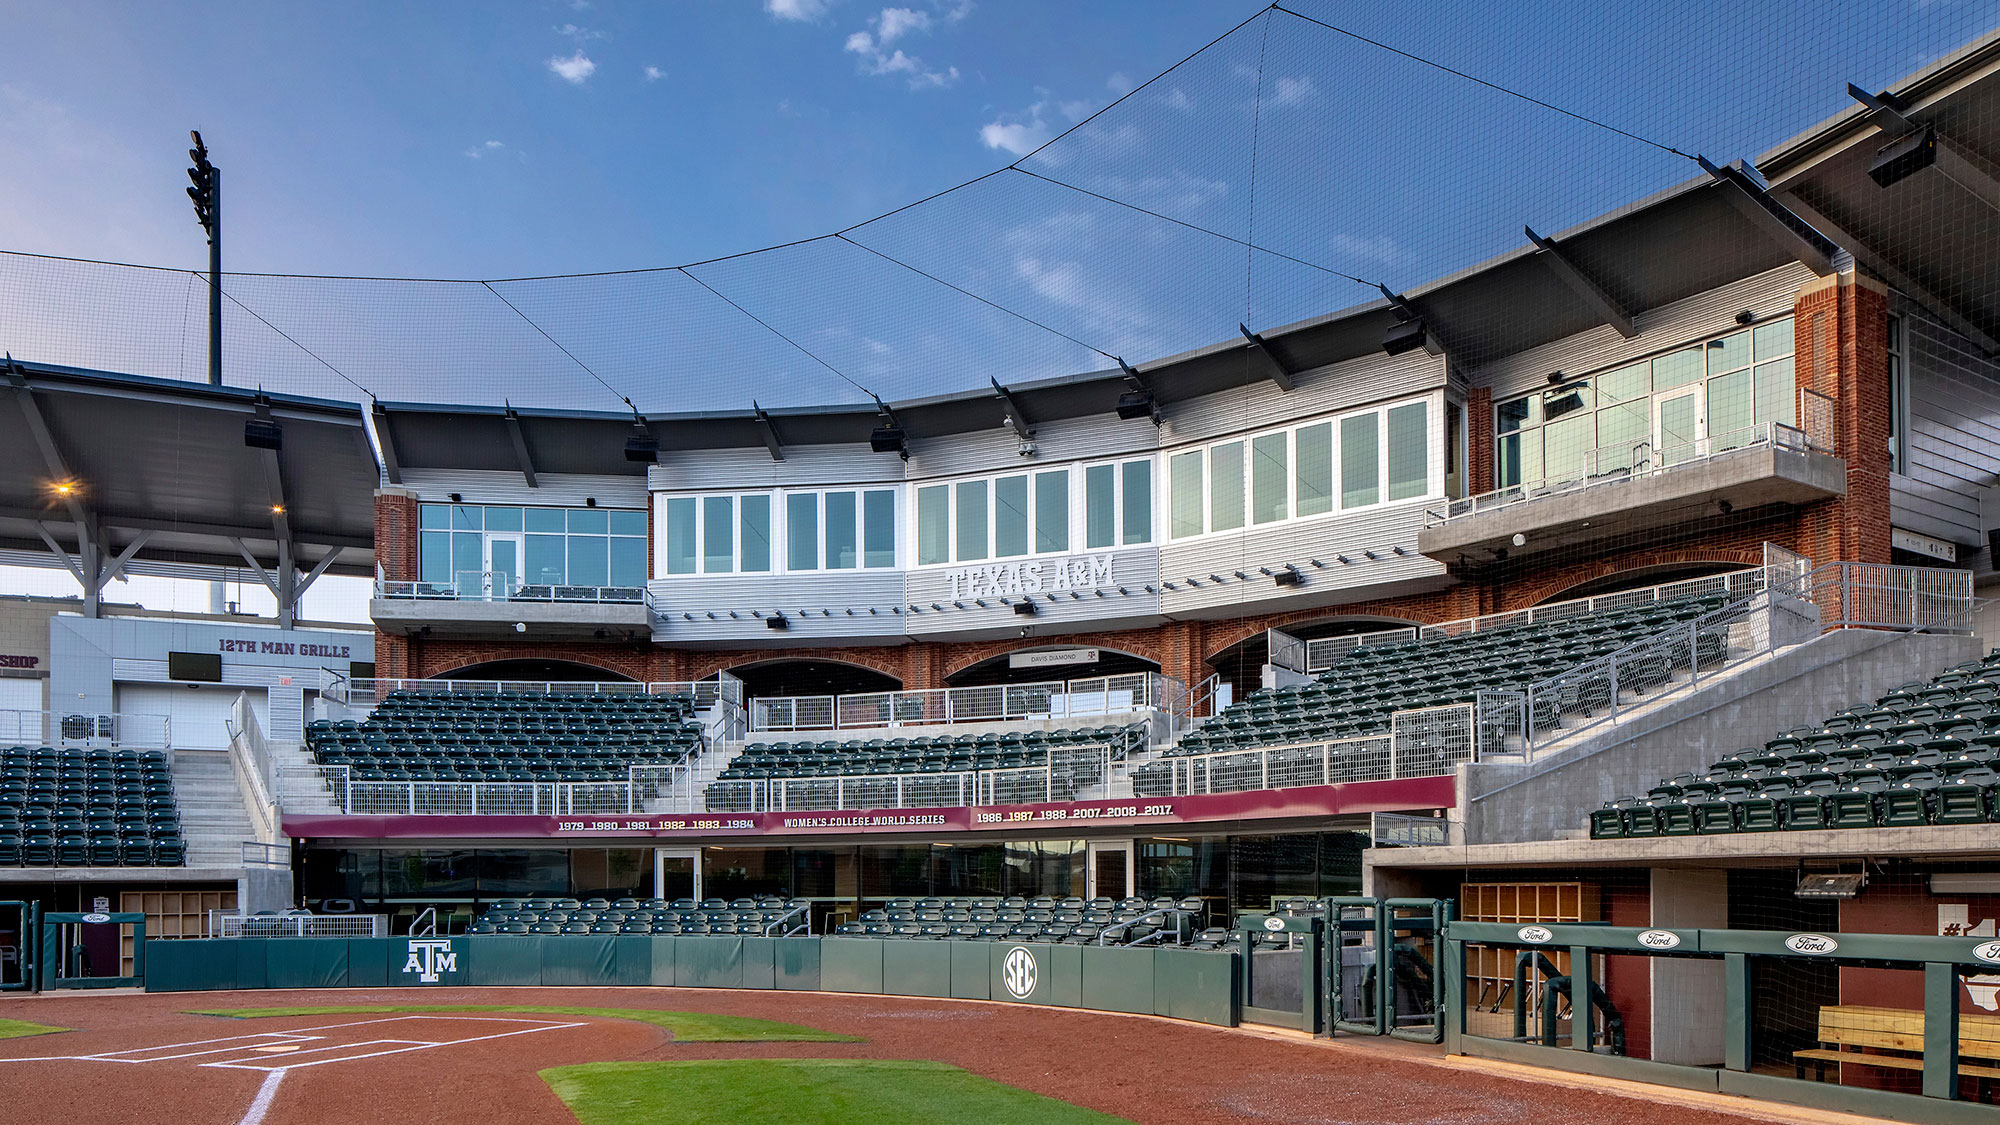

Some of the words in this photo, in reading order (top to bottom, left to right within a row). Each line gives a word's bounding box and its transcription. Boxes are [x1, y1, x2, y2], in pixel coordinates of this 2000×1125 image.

[945, 562, 1043, 602] TEXAS
[1053, 554, 1115, 592] A&M
[219, 639, 256, 653] 12TH
[261, 641, 295, 655] MAN
[299, 643, 350, 658] GRILLE
[1031, 655, 1048, 663] DAVIS
[1049, 653, 1076, 661] DIAMOND
[977, 813, 1003, 823] 1986
[1008, 811, 1034, 822] 1987
[1041, 810, 1067, 820] 1988
[1073, 808, 1101, 819] 2007
[1107, 807, 1137, 817] 2008
[1144, 805, 1172, 816] 2017
[558, 822, 584, 831] 1979
[591, 822, 618, 831] 1980
[625, 821, 651, 831] 1981
[658, 821, 686, 830] 1982
[692, 820, 720, 830] 1983
[727, 819, 754, 829] 1984
[784, 818, 826, 828] WOMEN'S
[830, 816, 869, 827] COLLEGE
[873, 816, 905, 826] WORLD
[909, 815, 945, 825] SERIES
[1524, 929, 1546, 940] Ford
[1645, 932, 1671, 946] Ford
[1795, 936, 1826, 951] Ford
[1006, 950, 1034, 995] SEC
